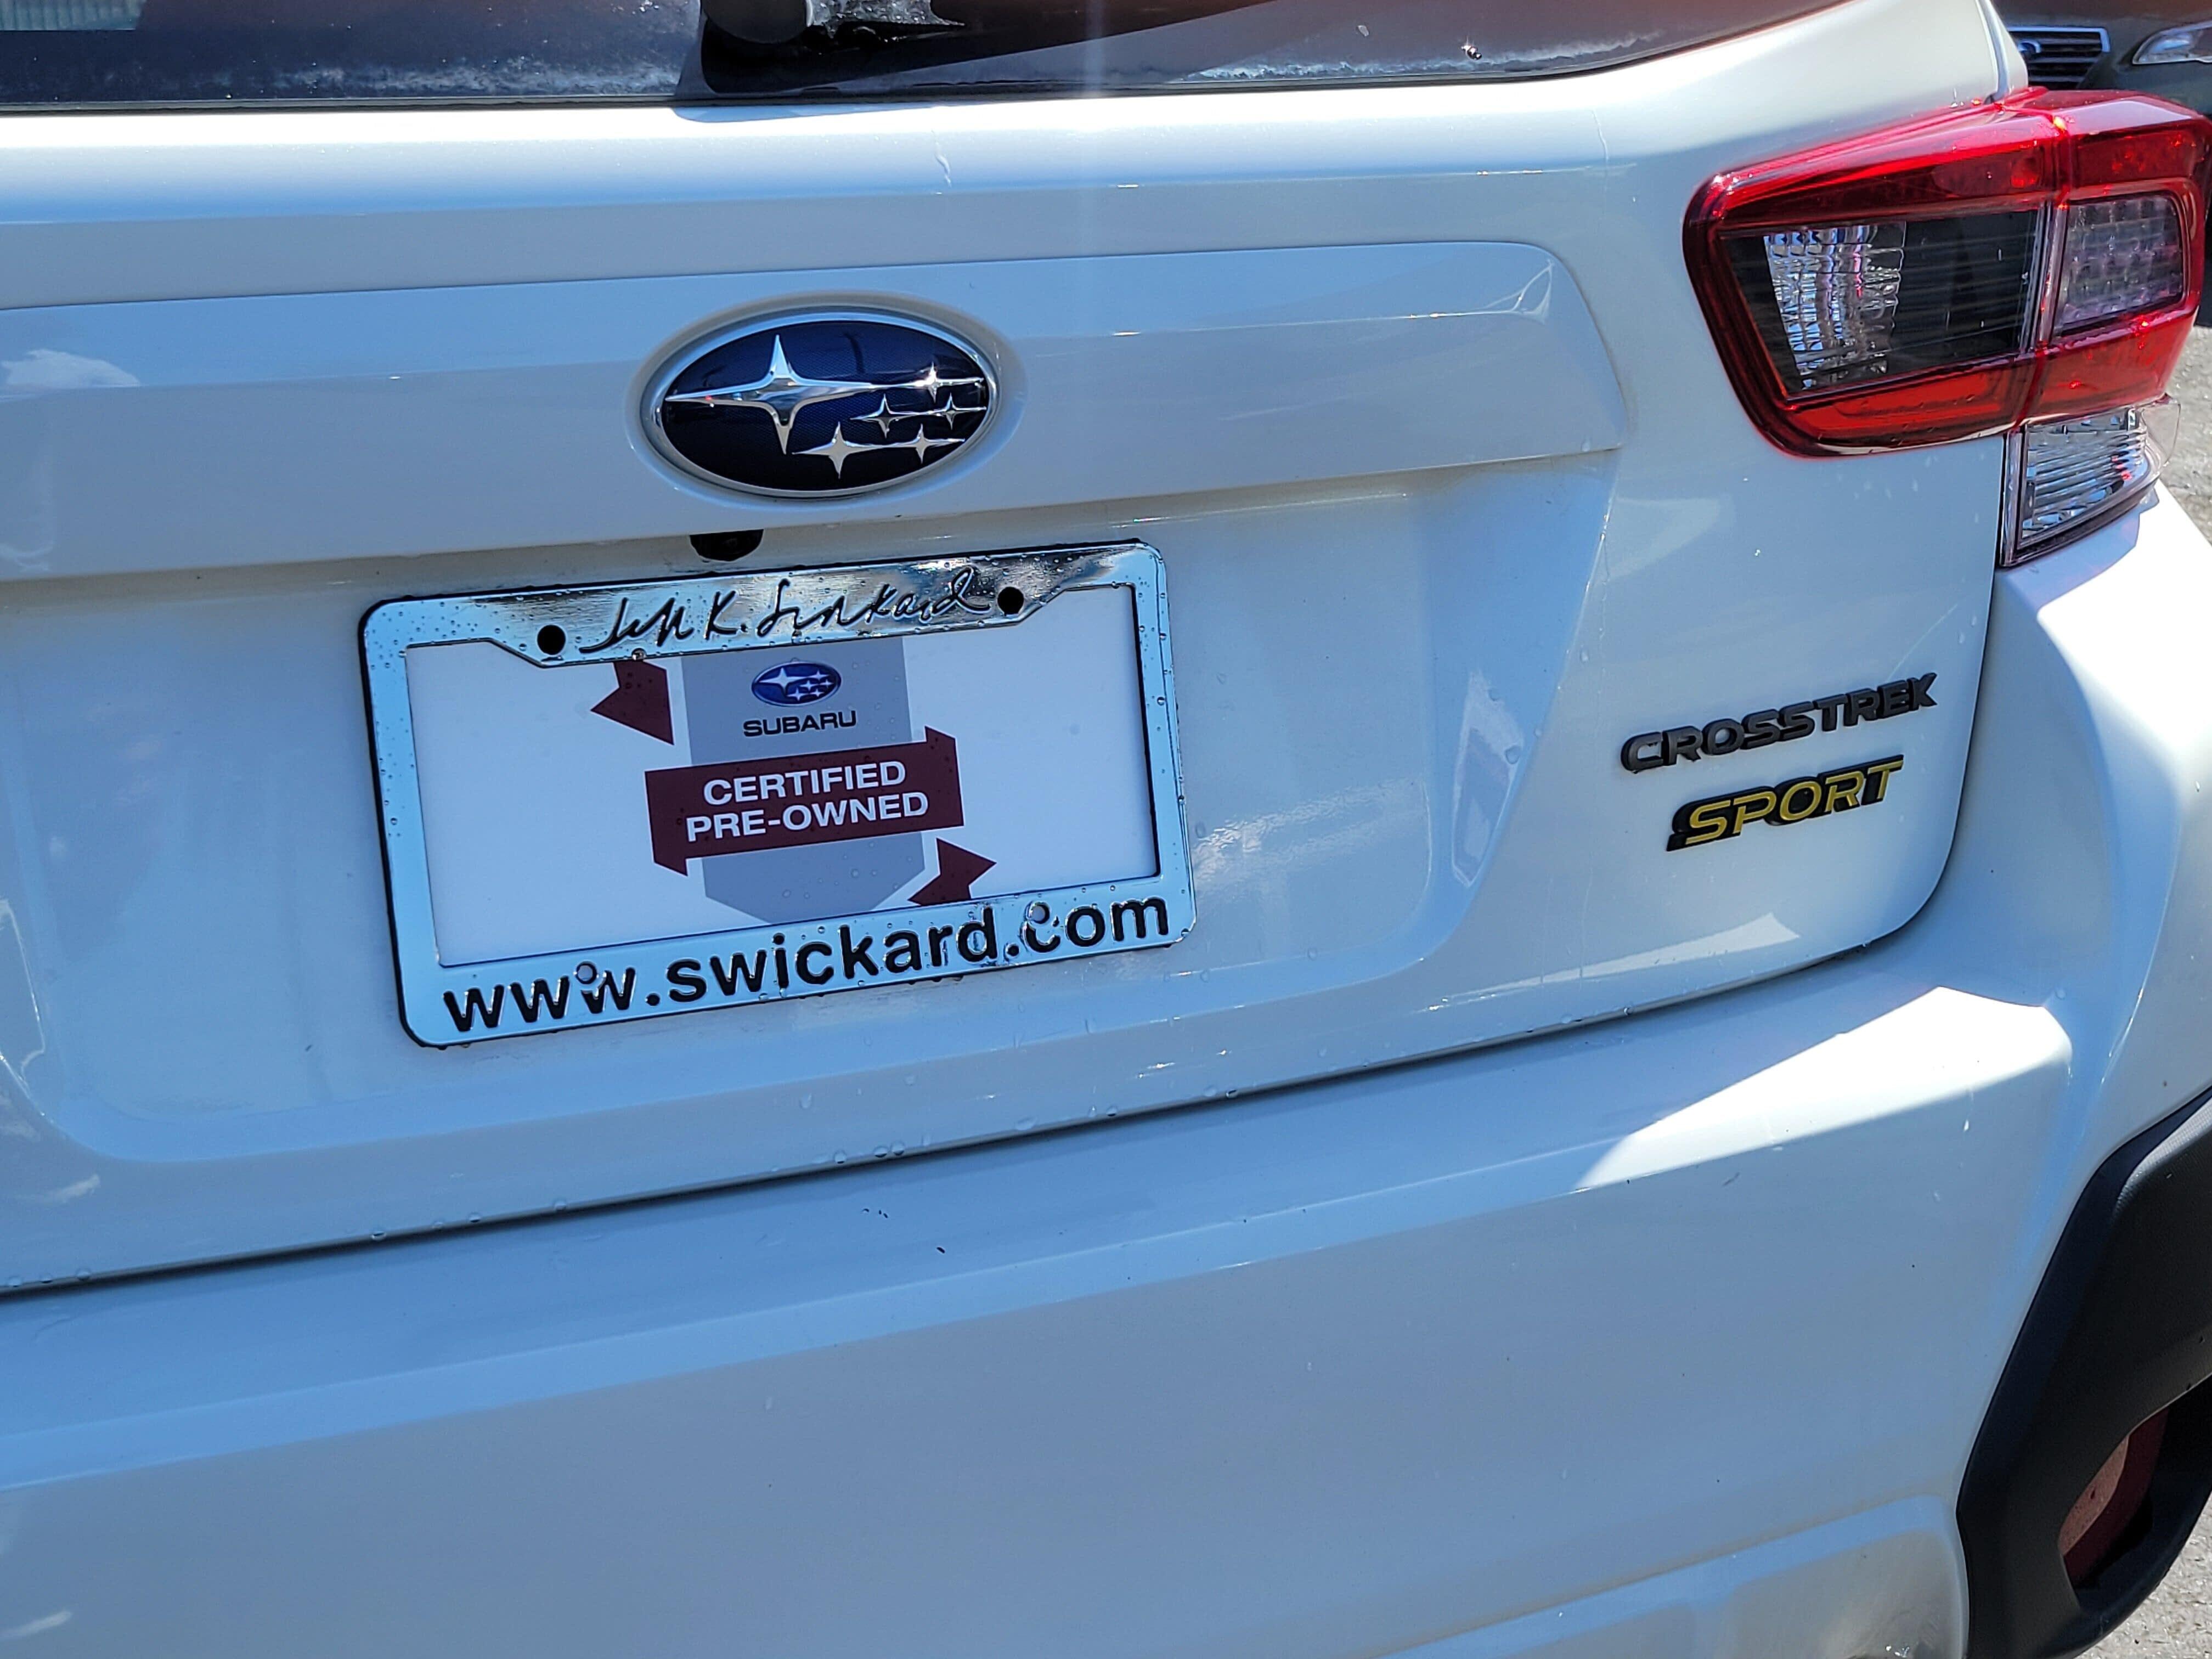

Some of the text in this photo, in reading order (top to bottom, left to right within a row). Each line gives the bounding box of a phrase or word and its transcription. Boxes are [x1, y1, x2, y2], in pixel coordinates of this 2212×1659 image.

[704, 590, 748, 640] K.
[743, 710, 856, 737] SUBARU
[1621, 672, 1938, 774] CROSSTREK
[703, 760, 906, 805] CERTIFIED
[1666, 754, 1904, 852] SPORT
[686, 791, 929, 842] PRE-OWNED
[442, 896, 1170, 1032] www.swickard.com
